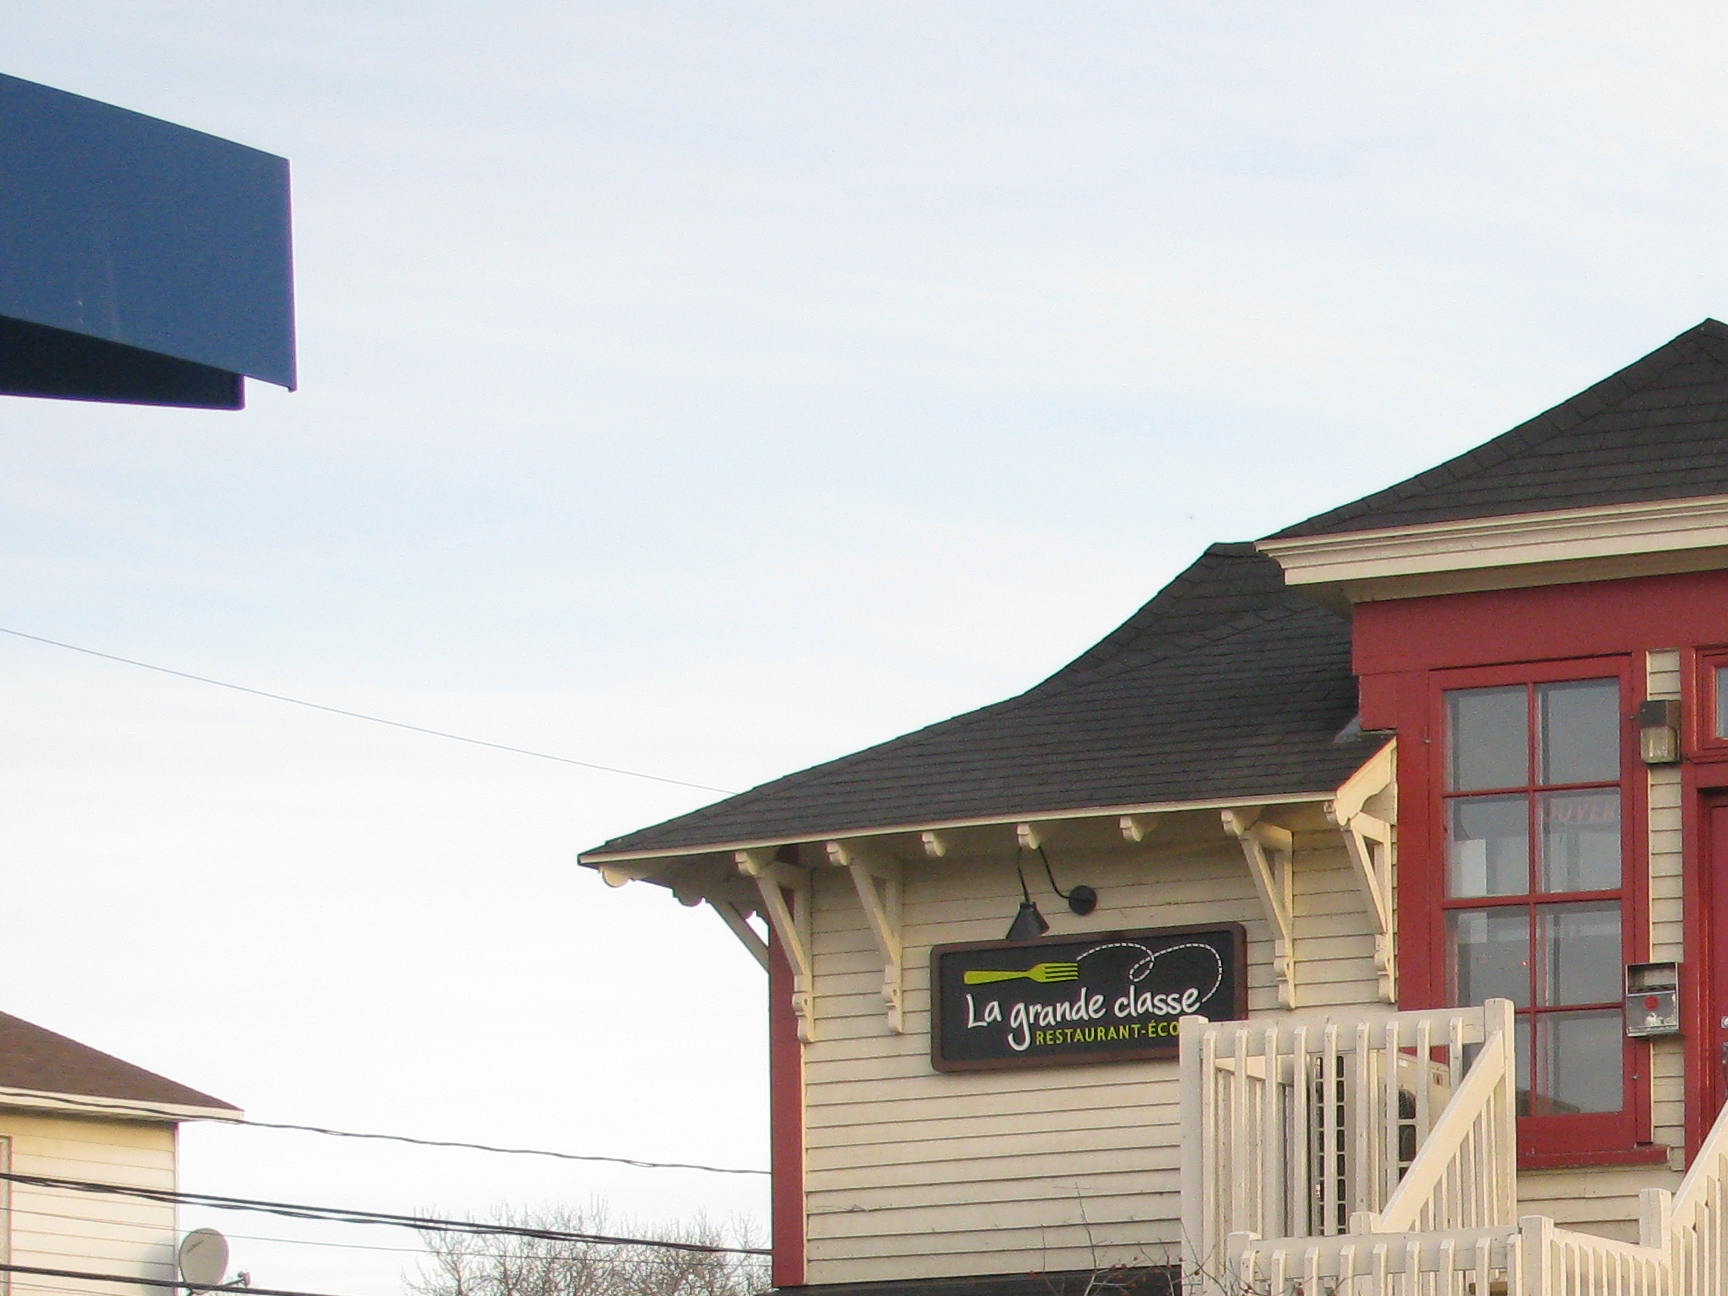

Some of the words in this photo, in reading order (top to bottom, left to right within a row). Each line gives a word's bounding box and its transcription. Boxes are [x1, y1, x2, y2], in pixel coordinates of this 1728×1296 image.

[966, 993, 1002, 1029] La
[1007, 985, 1106, 1051] grande
[1114, 985, 1201, 1018] classe
